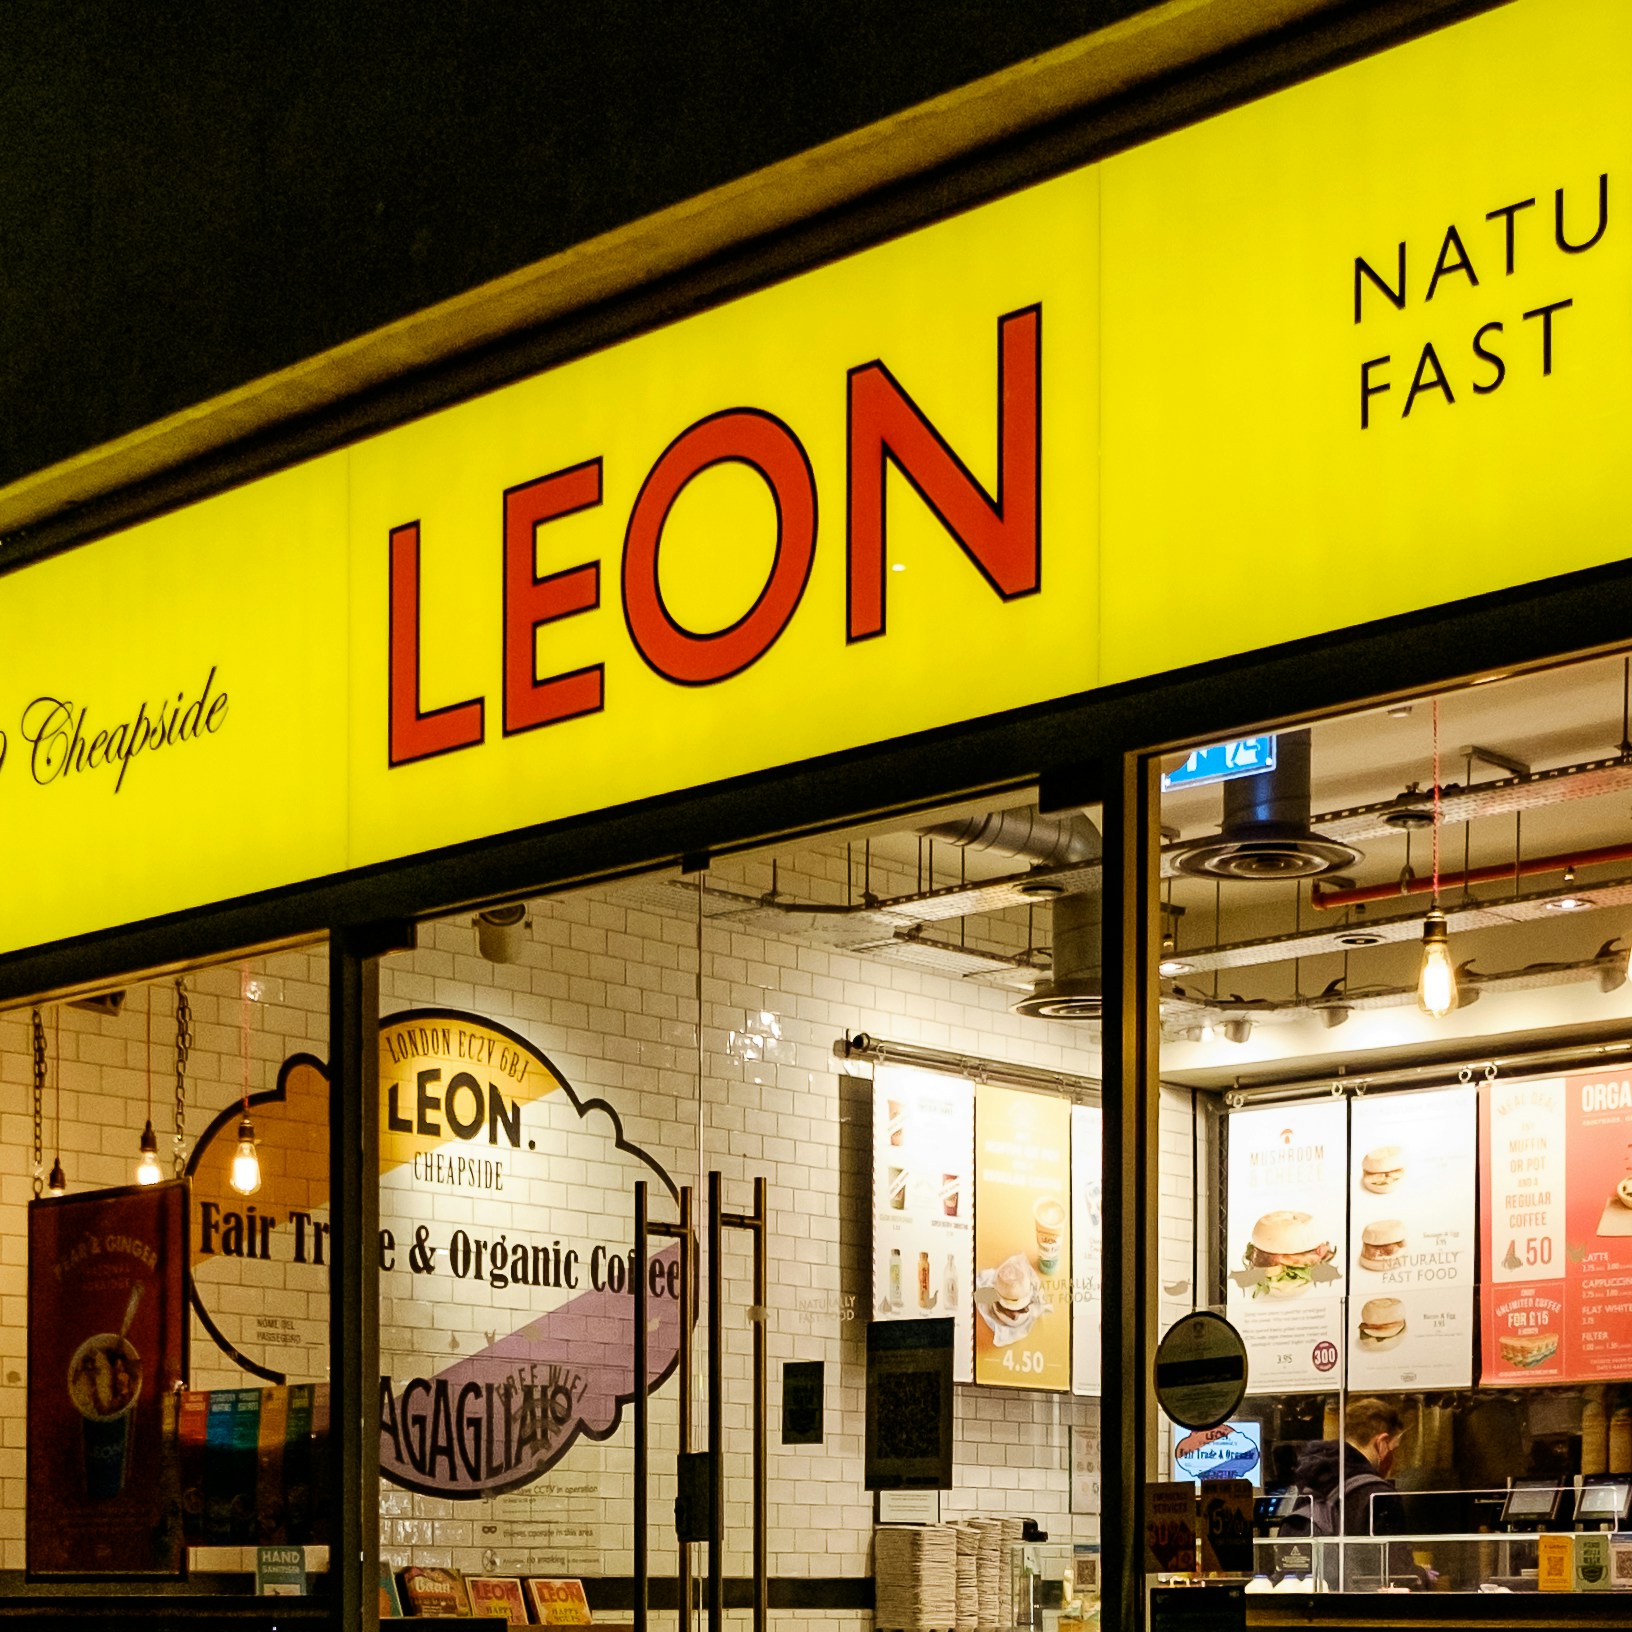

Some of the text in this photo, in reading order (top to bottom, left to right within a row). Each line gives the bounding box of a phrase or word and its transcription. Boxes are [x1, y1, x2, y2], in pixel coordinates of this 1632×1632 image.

[1360, 298, 1573, 430] FAST
[387, 303, 1043, 769] LEON
[20, 665, 230, 795] Cheapside
[386, 1028, 530, 1083] LONDON EC2V 6BJ
[1508, 1135, 1548, 1153] MUFFIN
[1249, 1144, 1324, 1168] MUSHROOM
[1510, 1155, 1547, 1174] OR POT
[414, 1151, 504, 1192] CHEAPSIDE
[1517, 1177, 1532, 1188] AND
[1505, 1191, 1552, 1210] REGULAR
[1509, 1211, 1548, 1229] COFFEE
[199, 1201, 277, 1261] Fair
[408, 1224, 437, 1276] &
[449, 1228, 580, 1290] Organic
[590, 1244, 681, 1300] Coee
[1382, 1251, 1460, 1270] NATURALLY
[1382, 1266, 1458, 1284] FAST FOOD
[1495, 1298, 1534, 1317] UNLIMITED
[1507, 1312, 1527, 1328] FOR
[1581, 1331, 1609, 1342] FILTER
[1002, 1349, 1045, 1374] 4.50
[1313, 1347, 1336, 1365] 300
[495, 1362, 588, 1407] FREE WIFI
[380, 1375, 572, 1484] AGAGLIAIO
[533, 1484, 556, 1495] CCTV
[564, 1485, 598, 1495] operation
[262, 1550, 301, 1564] HAND
[472, 1582, 521, 1601] LEON
[536, 1583, 585, 1604] LEON
